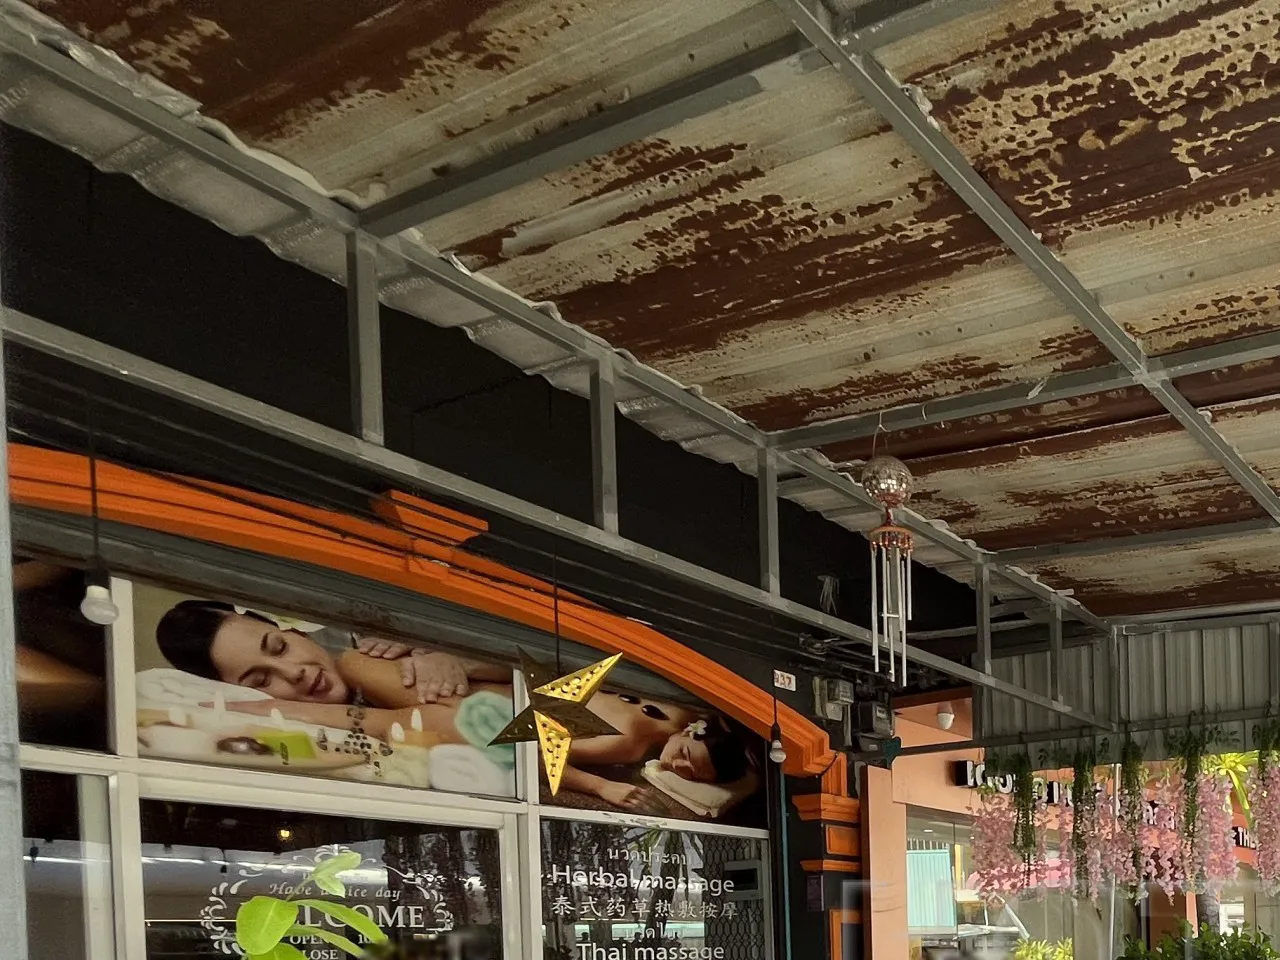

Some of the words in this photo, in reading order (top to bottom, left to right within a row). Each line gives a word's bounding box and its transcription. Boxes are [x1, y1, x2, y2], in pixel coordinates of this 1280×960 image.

[552, 864, 635, 888] Herbal
[642, 874, 735, 896] massage
[375, 884, 401, 902] day
[241, 904, 425, 929] LCOME
[301, 949, 339, 960] LOSE
